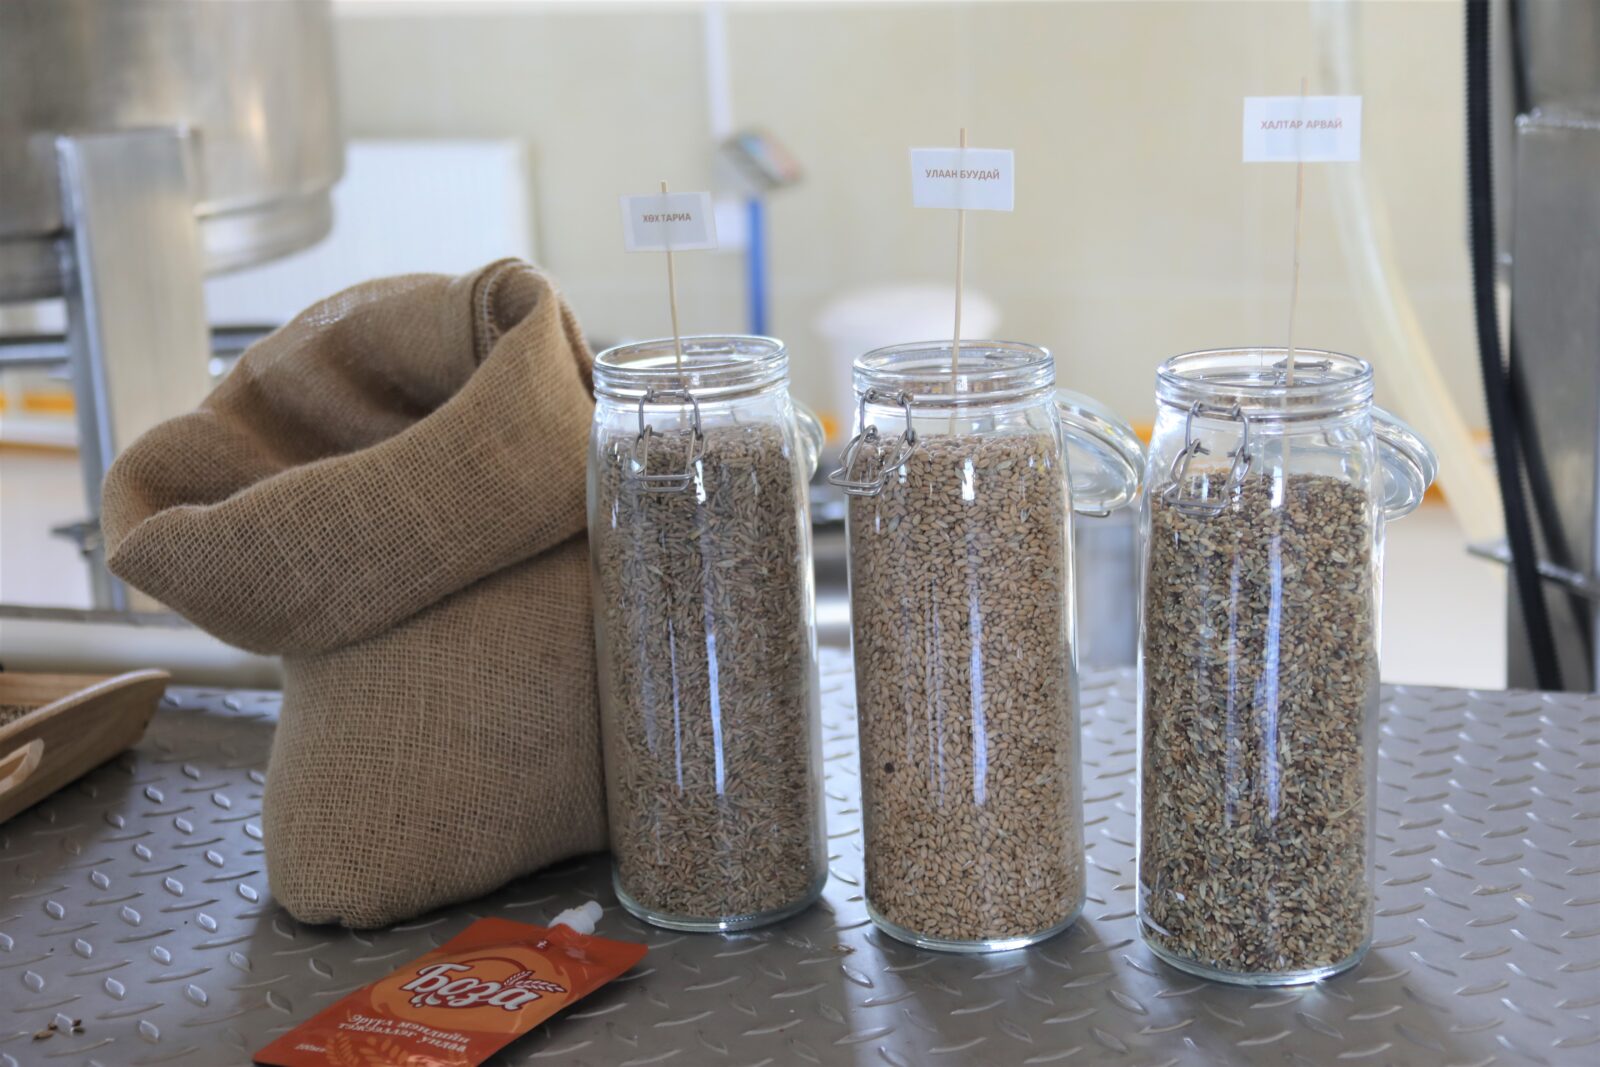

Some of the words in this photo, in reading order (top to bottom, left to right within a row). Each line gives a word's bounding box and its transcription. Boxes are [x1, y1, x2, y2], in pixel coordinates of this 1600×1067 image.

[1260, 119, 1303, 130] ХАЛТАР
[1306, 117, 1343, 129] АРВАЙ
[925, 168, 958, 179] УЛААН
[959, 168, 1000, 181] БУУДАЙ
[661, 212, 692, 223] ТАРИА
[400, 962, 541, 1011] Боза
